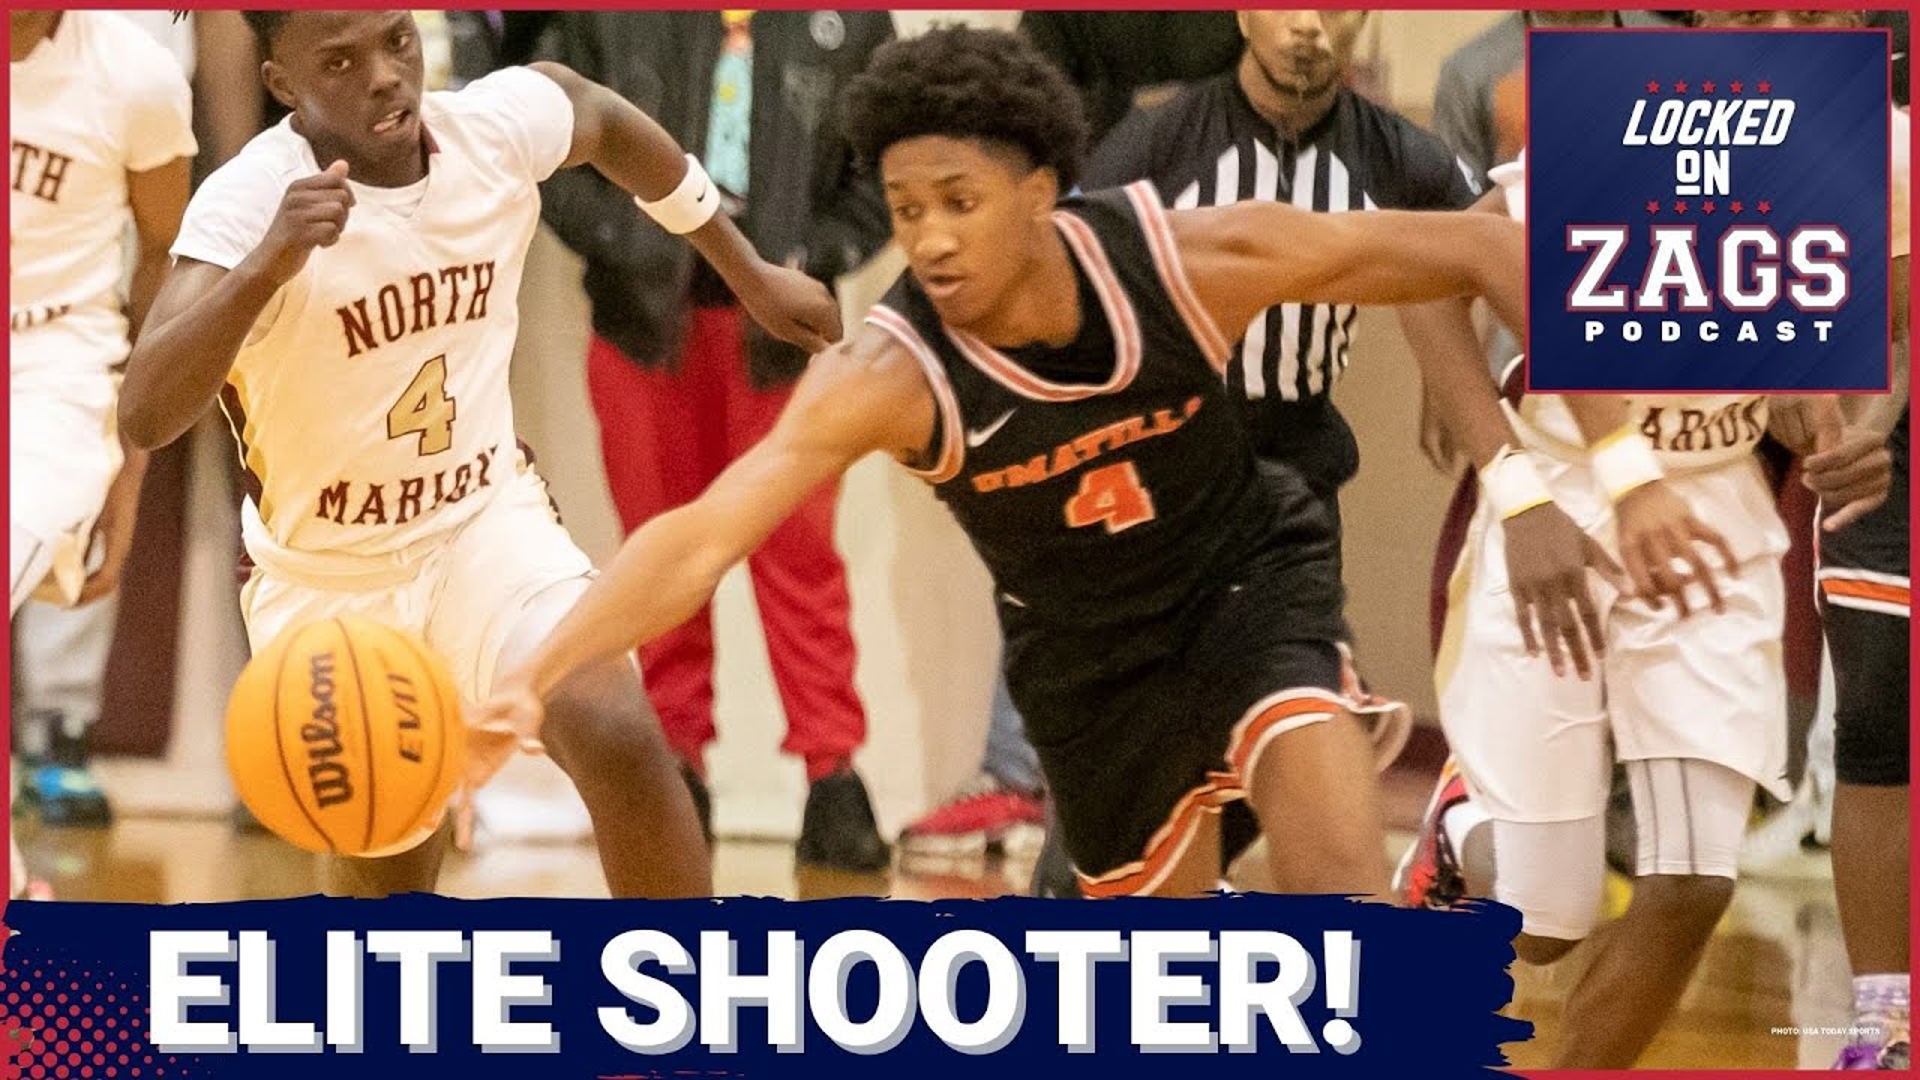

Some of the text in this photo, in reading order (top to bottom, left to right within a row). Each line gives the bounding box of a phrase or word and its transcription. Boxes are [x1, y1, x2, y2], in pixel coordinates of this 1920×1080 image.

[336, 260, 496, 358] NORTH
[386, 353, 457, 457] 4
[1063, 460, 1155, 534] 4
[301, 652, 354, 810] Wilson
